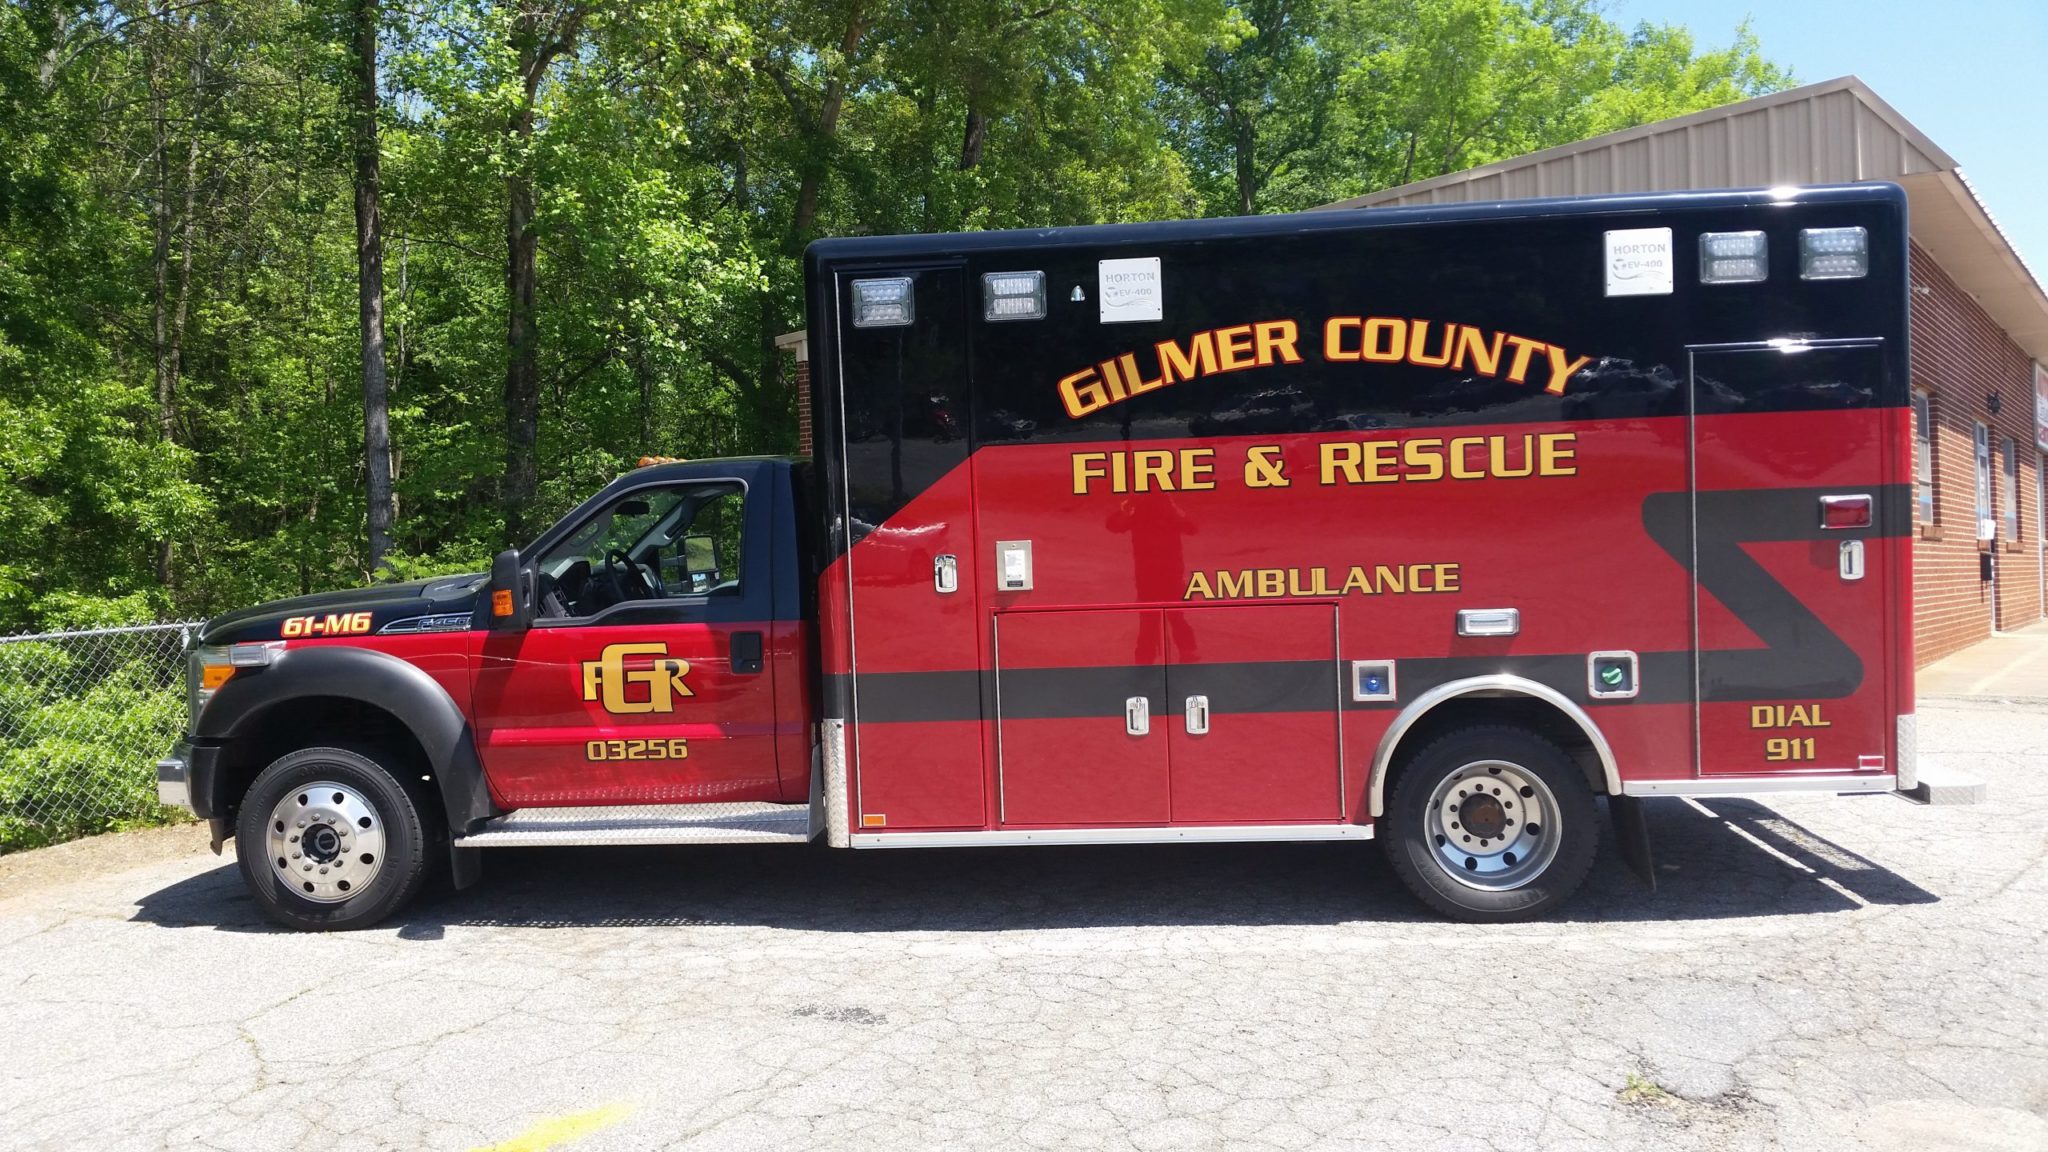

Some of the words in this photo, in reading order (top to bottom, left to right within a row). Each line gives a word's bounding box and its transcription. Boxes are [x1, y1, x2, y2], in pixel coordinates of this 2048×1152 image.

[1613, 244, 1665, 255] HORTON
[1105, 272, 1155, 283] HORTON
[1120, 288, 1152, 297] EV-400
[1057, 319, 1304, 419] GILMER
[1323, 316, 1594, 396] COUNTY
[1071, 447, 1216, 495] FIRE
[1243, 445, 1291, 488] &
[1319, 432, 1578, 485] RESCUE
[1183, 563, 1461, 600] AMBULANCE
[281, 611, 373, 637] 61-M6
[1750, 704, 1832, 729] DIAL
[586, 738, 689, 761] 03256
[1765, 736, 1816, 762] 911
